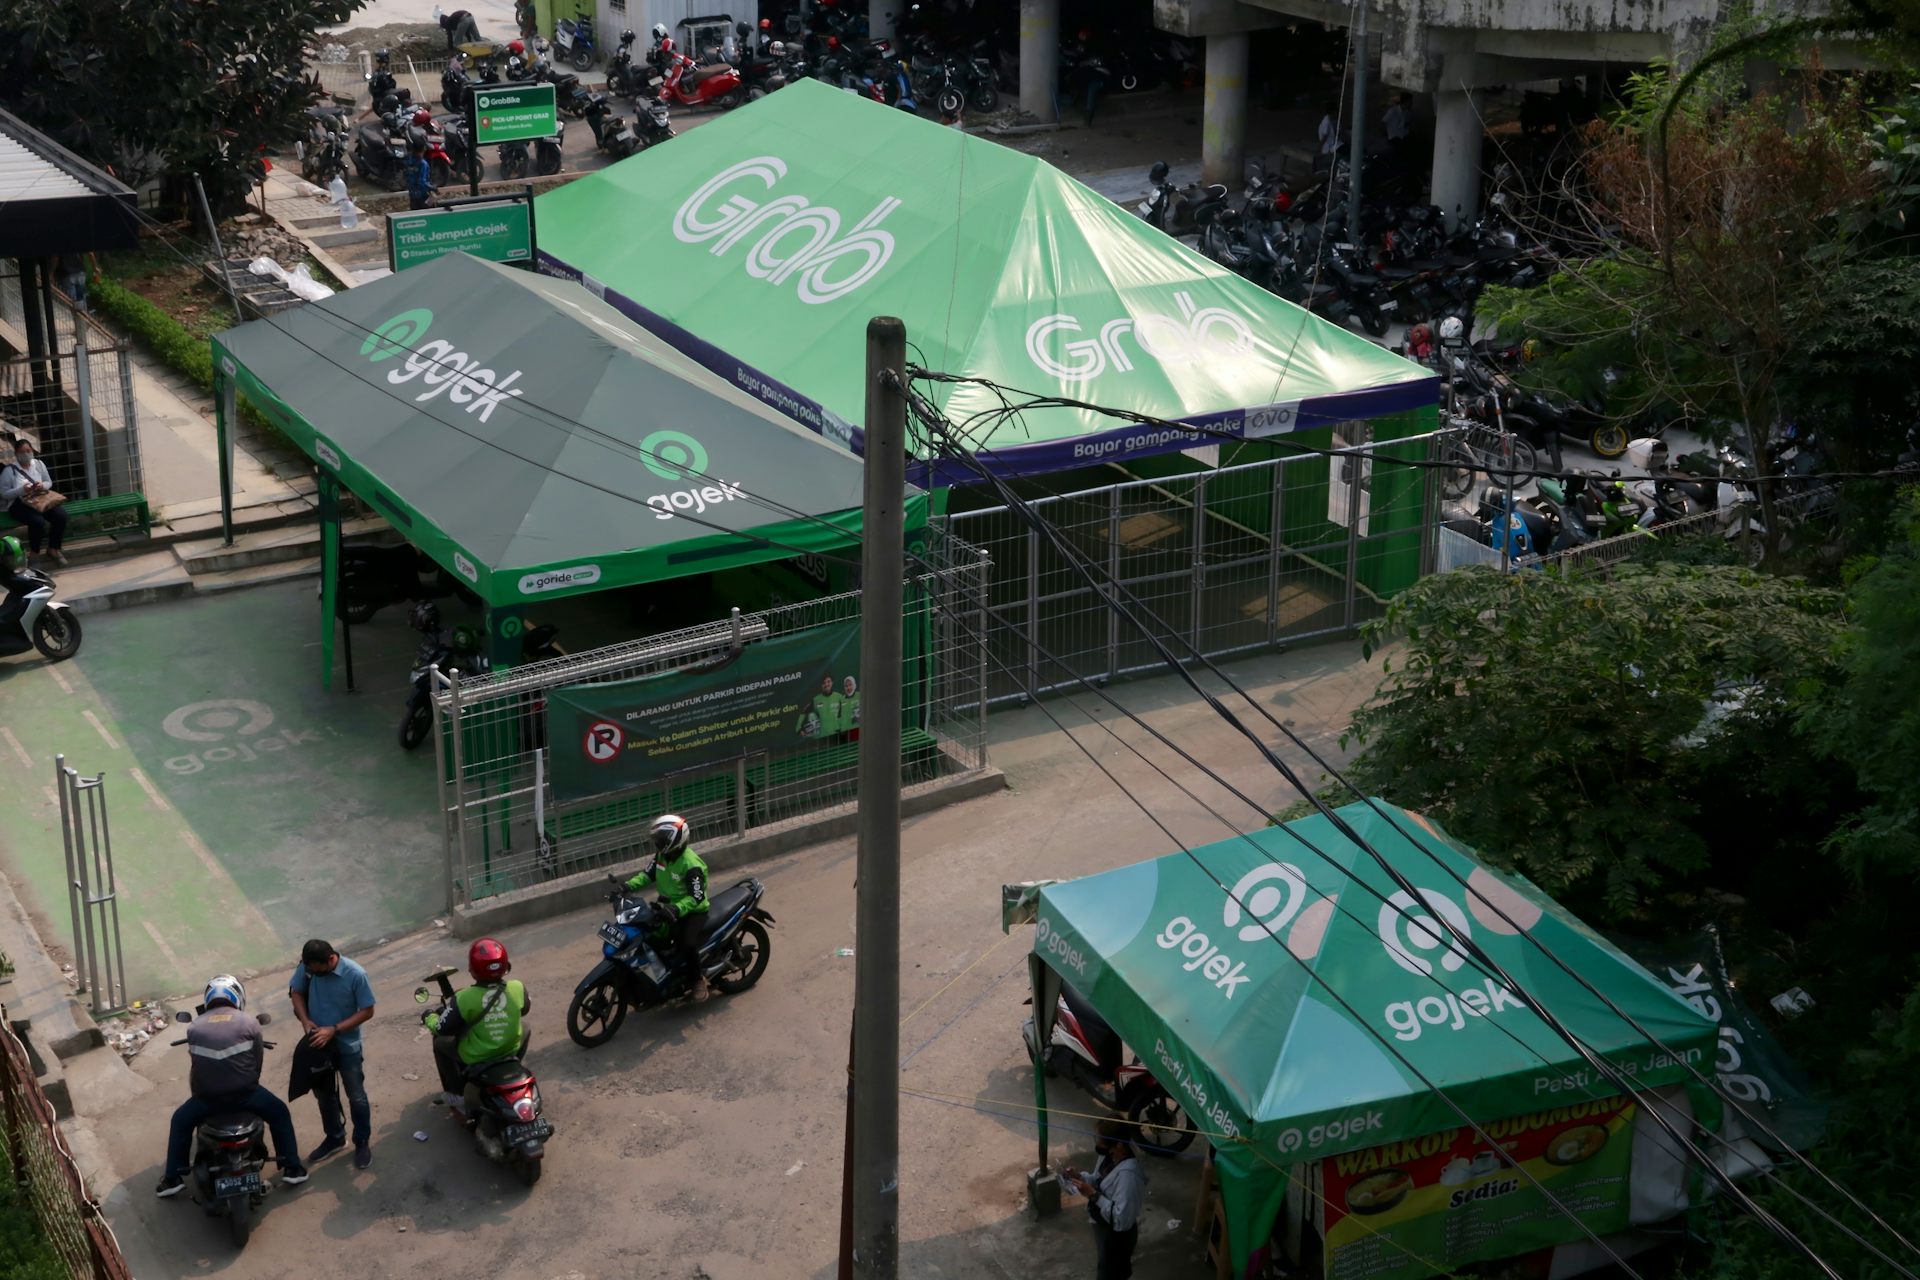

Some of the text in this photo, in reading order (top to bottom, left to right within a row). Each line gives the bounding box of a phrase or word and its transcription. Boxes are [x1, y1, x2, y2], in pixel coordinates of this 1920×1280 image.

[491, 97, 520, 105] GrabBike
[400, 223, 508, 244] Titik Jemput Gojek
[673, 156, 902, 304] Grab
[1025, 291, 1254, 381] Grab
[387, 340, 523, 423] gojek
[737, 367, 760, 392] Bayar
[761, 383, 799, 414] gampang
[1074, 439, 1121, 458] Bayar
[647, 479, 748, 520] gojek
[537, 574, 571, 588] goride
[626, 671, 802, 721] DILARANG UNTUK PARKIR DIDEPAN PAGAR
[659, 733, 671, 744] Ke
[672, 726, 698, 741] Dalam
[698, 719, 728, 736] Shelter
[730, 714, 754, 727] untuk
[756, 708, 781, 722] Parkir
[782, 704, 799, 715] dan
[675, 736, 712, 752] Gunakan
[714, 729, 743, 745] Atribut
[744, 719, 780, 738] Lengkap
[1047, 931, 1087, 976] gojek
[1156, 916, 1251, 1000] gojek
[1384, 977, 1527, 1041] gojek
[1154, 1038, 1241, 1142] Pasti Ada Jalan
[1534, 1067, 1589, 1096] Pasti
[1643, 1047, 1702, 1072] Jalan
[1307, 1110, 1383, 1148] gojek
[1334, 1128, 1460, 1178] WARKOP
[1449, 1178, 1519, 1209] Sedia:
